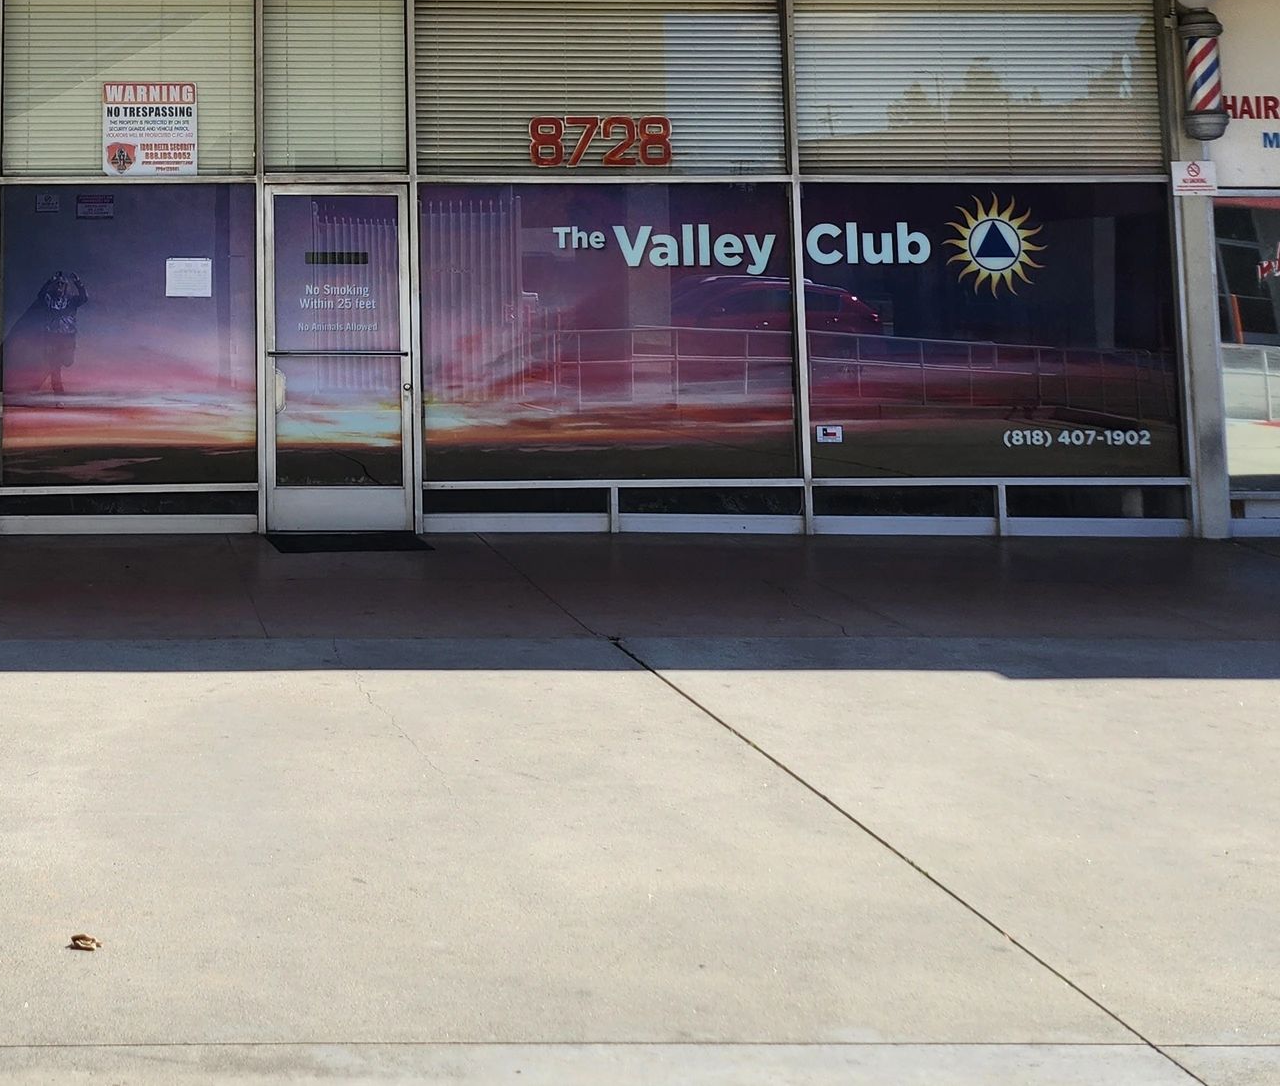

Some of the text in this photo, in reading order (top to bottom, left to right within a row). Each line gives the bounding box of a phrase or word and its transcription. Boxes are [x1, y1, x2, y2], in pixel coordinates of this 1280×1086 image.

[105, 84, 193, 102] WARNING
[106, 106, 193, 117] NO TRESPASSING
[528, 115, 673, 167] 8728
[553, 221, 932, 275] The Valley Club
[305, 284, 370, 297] No Smoking
[300, 298, 376, 309] Within 25 feet
[298, 323, 378, 331] No Animals Allowed
[1003, 429, 1152, 447] (818) 407-1902
